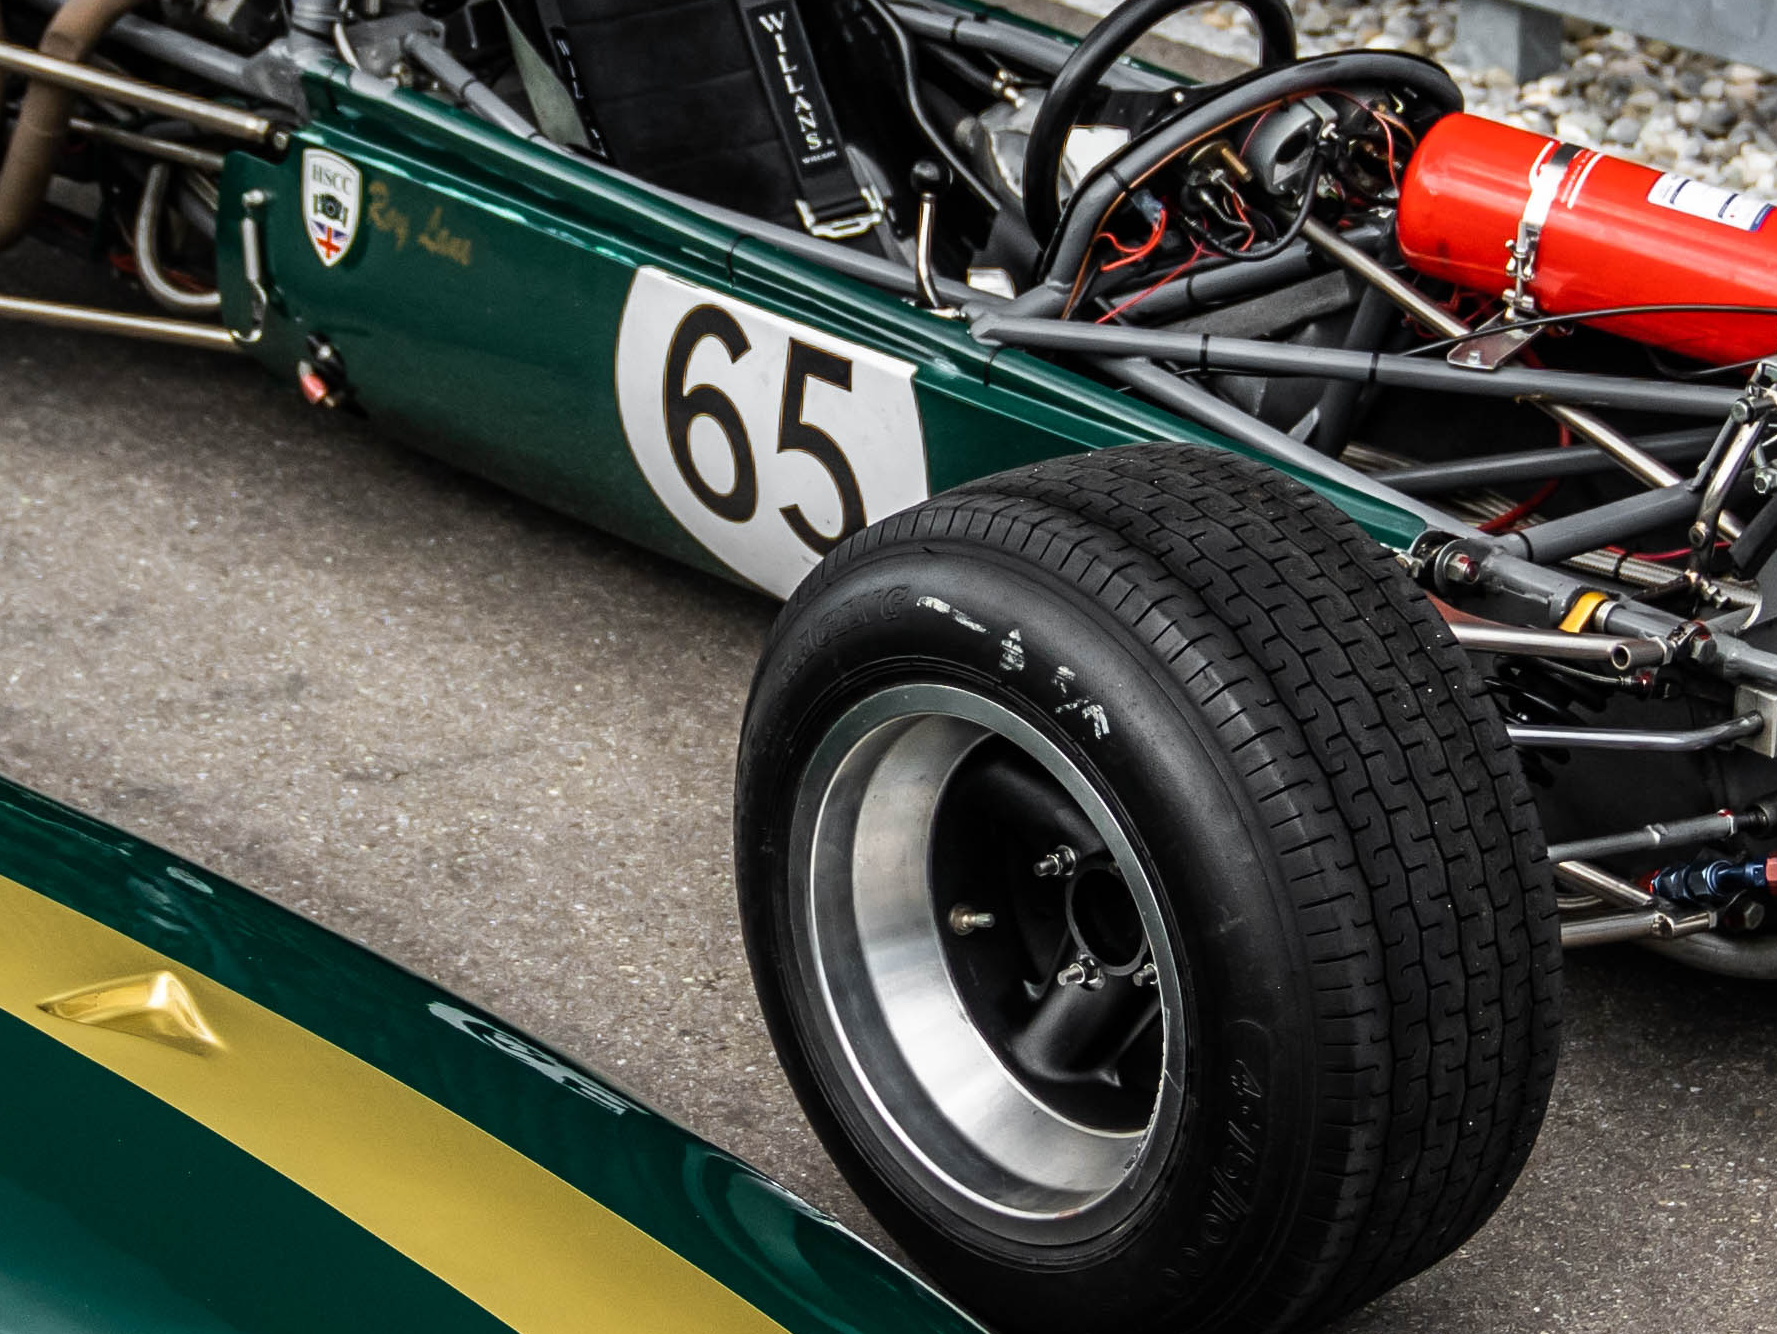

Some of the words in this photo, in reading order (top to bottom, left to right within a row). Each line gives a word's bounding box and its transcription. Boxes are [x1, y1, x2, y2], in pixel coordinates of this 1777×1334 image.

[758, 11, 823, 151] WILLANS
[312, 163, 353, 197] HSCC
[662, 303, 869, 559] 65
